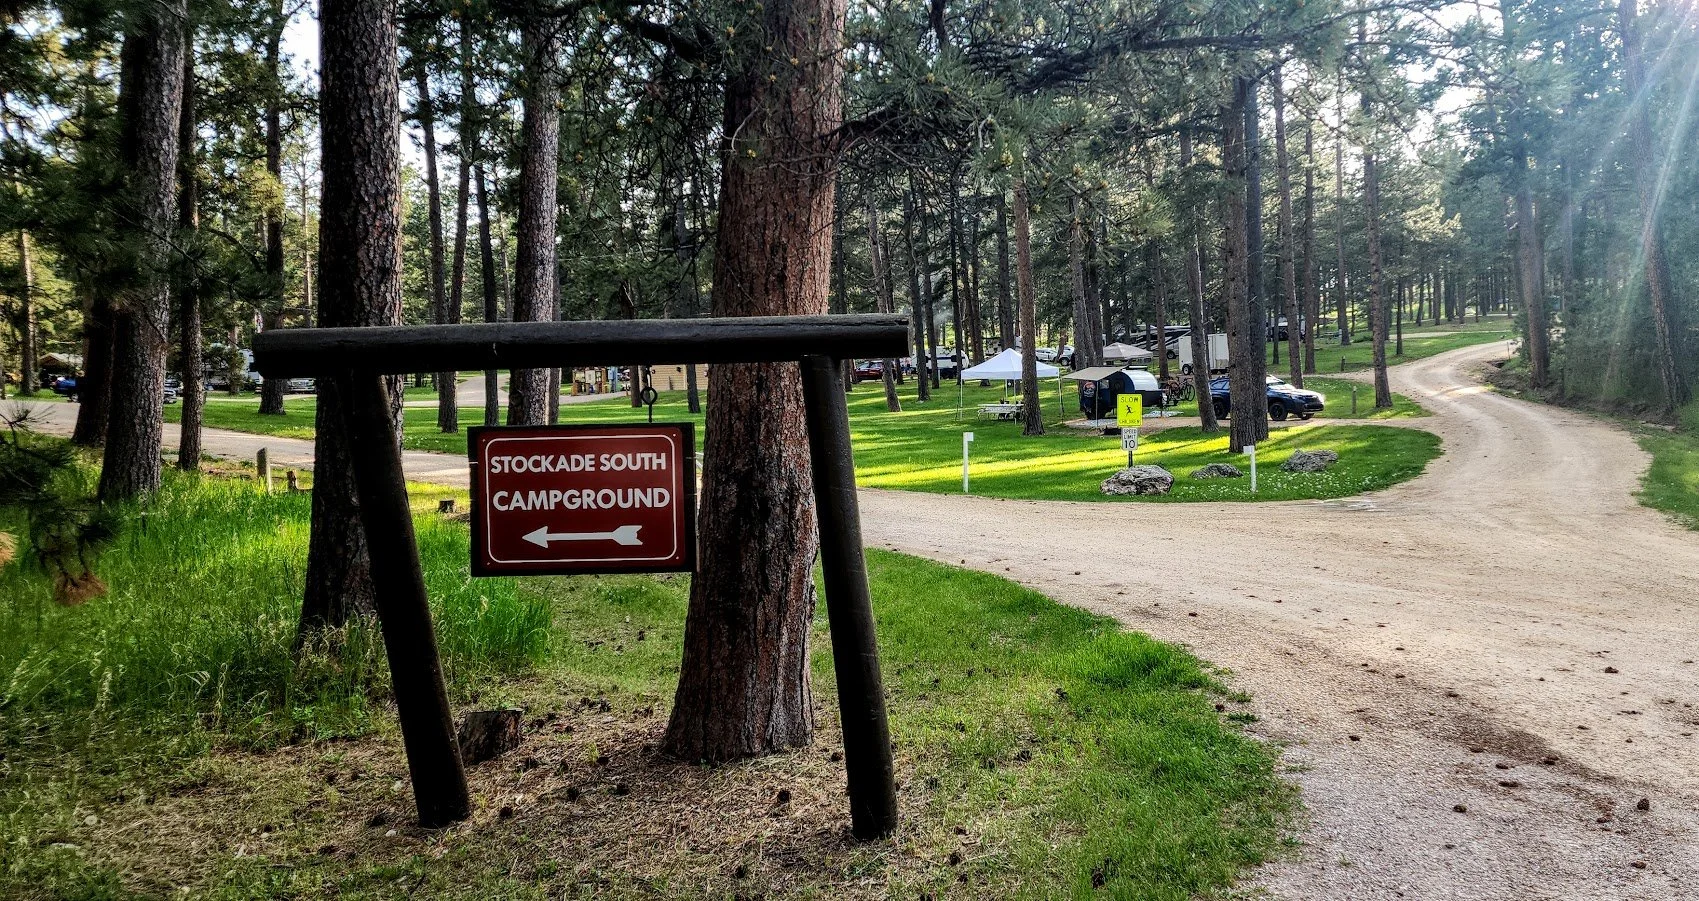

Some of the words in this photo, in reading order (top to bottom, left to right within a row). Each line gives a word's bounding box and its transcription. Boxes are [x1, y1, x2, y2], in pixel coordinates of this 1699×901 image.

[1124, 440, 1136, 449] 10
[491, 454, 595, 473] STOCKADE
[600, 453, 666, 471] SOUTH
[493, 487, 671, 511] CAMPGROUND
